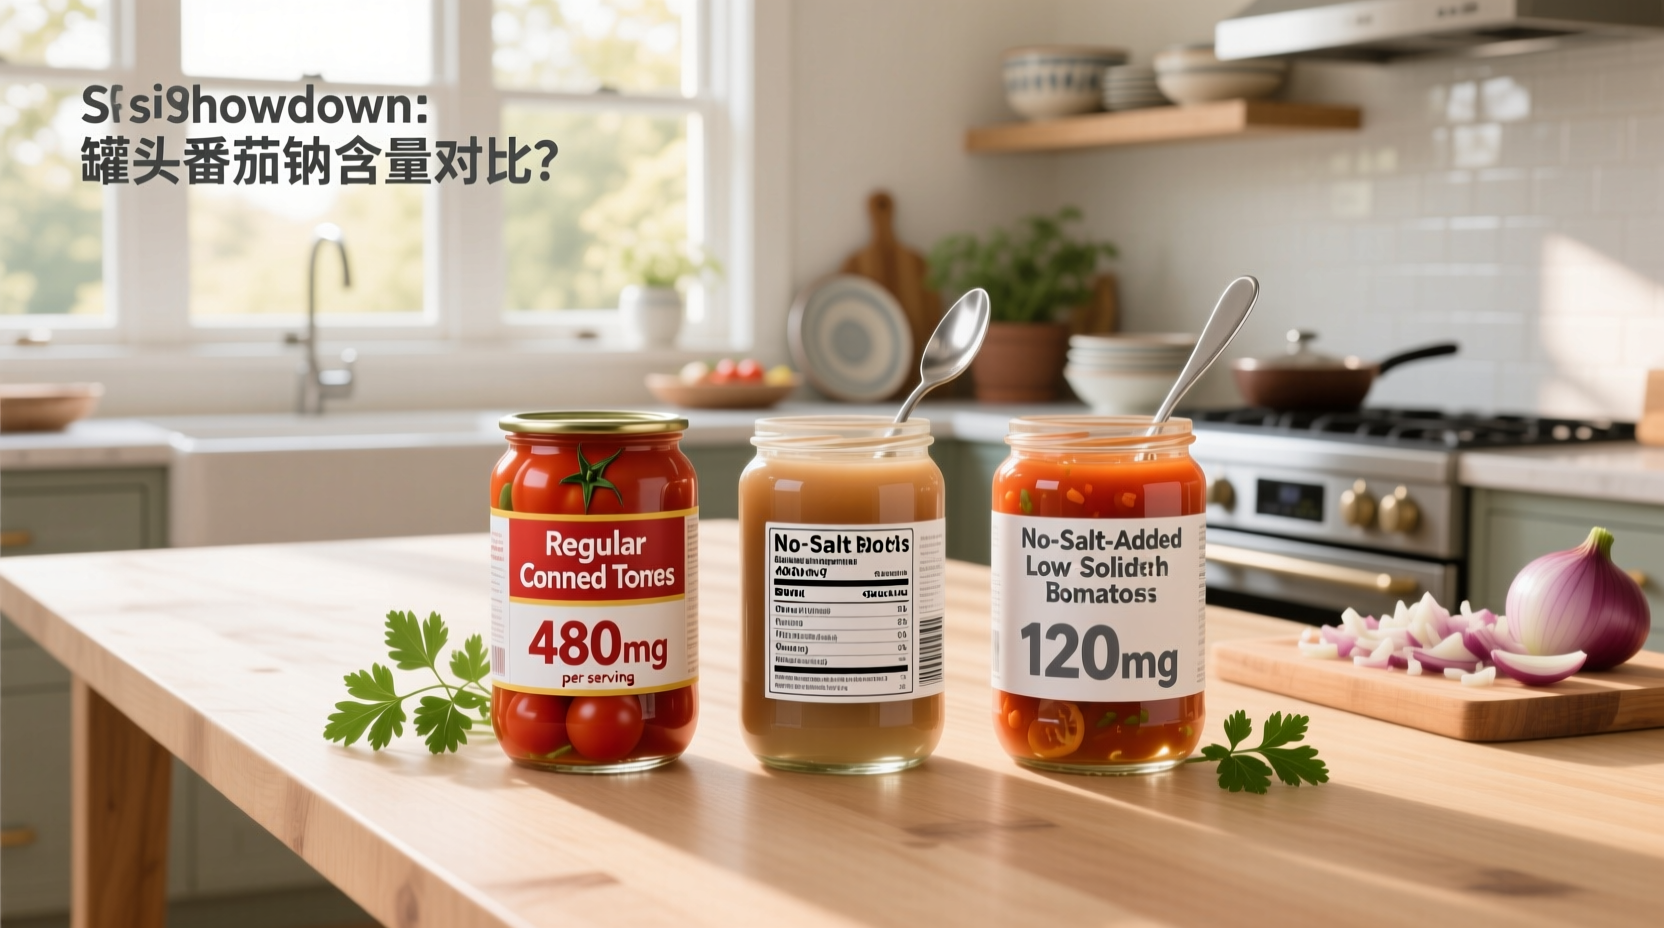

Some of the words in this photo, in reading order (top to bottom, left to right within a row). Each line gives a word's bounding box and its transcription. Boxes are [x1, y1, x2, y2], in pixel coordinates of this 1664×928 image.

[546, 529, 647, 564] Regular
[774, 533, 852, 554] No-Salt
[1021, 527, 1182, 551] No-Salt-Added
[520, 562, 606, 590] Conned
[1026, 555, 1072, 577] Low
[528, 619, 668, 670] 480mg
[1021, 622, 1179, 689] 120mg
[562, 672, 584, 687] per
[588, 670, 635, 687] serving
